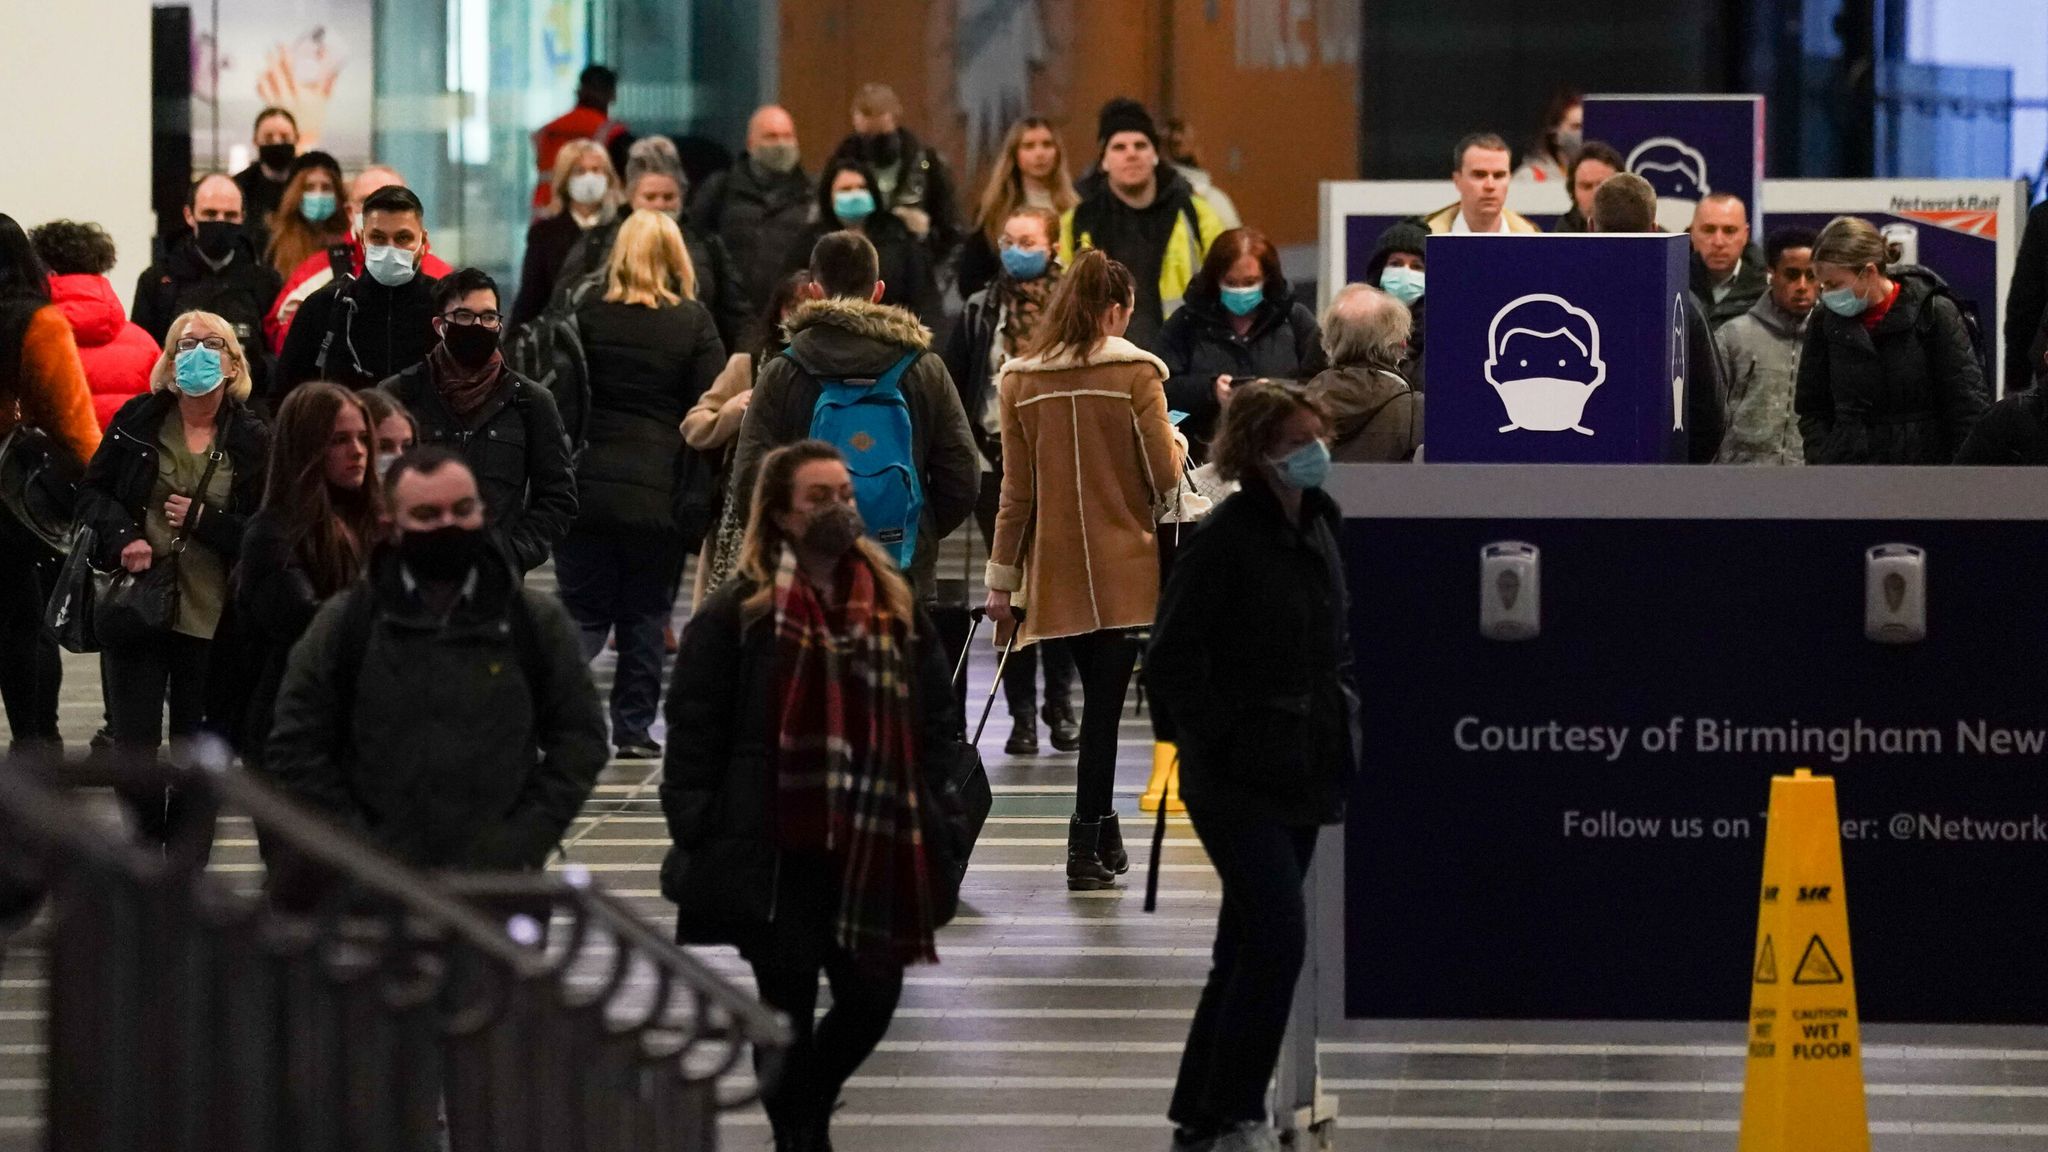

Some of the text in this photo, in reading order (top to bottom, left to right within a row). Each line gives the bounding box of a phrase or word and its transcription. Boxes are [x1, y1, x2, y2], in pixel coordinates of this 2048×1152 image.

[1453, 715, 2047, 762] Courtesy of Birmingham New
[1563, 810, 1661, 838] Follow
[1671, 816, 1703, 838] us
[1712, 817, 1750, 838] on
[1888, 813, 2048, 841] @Network
[1792, 1008, 1848, 1019] CAUTION
[1802, 1023, 1839, 1039] WET
[1793, 1042, 1851, 1060] FLOOR
